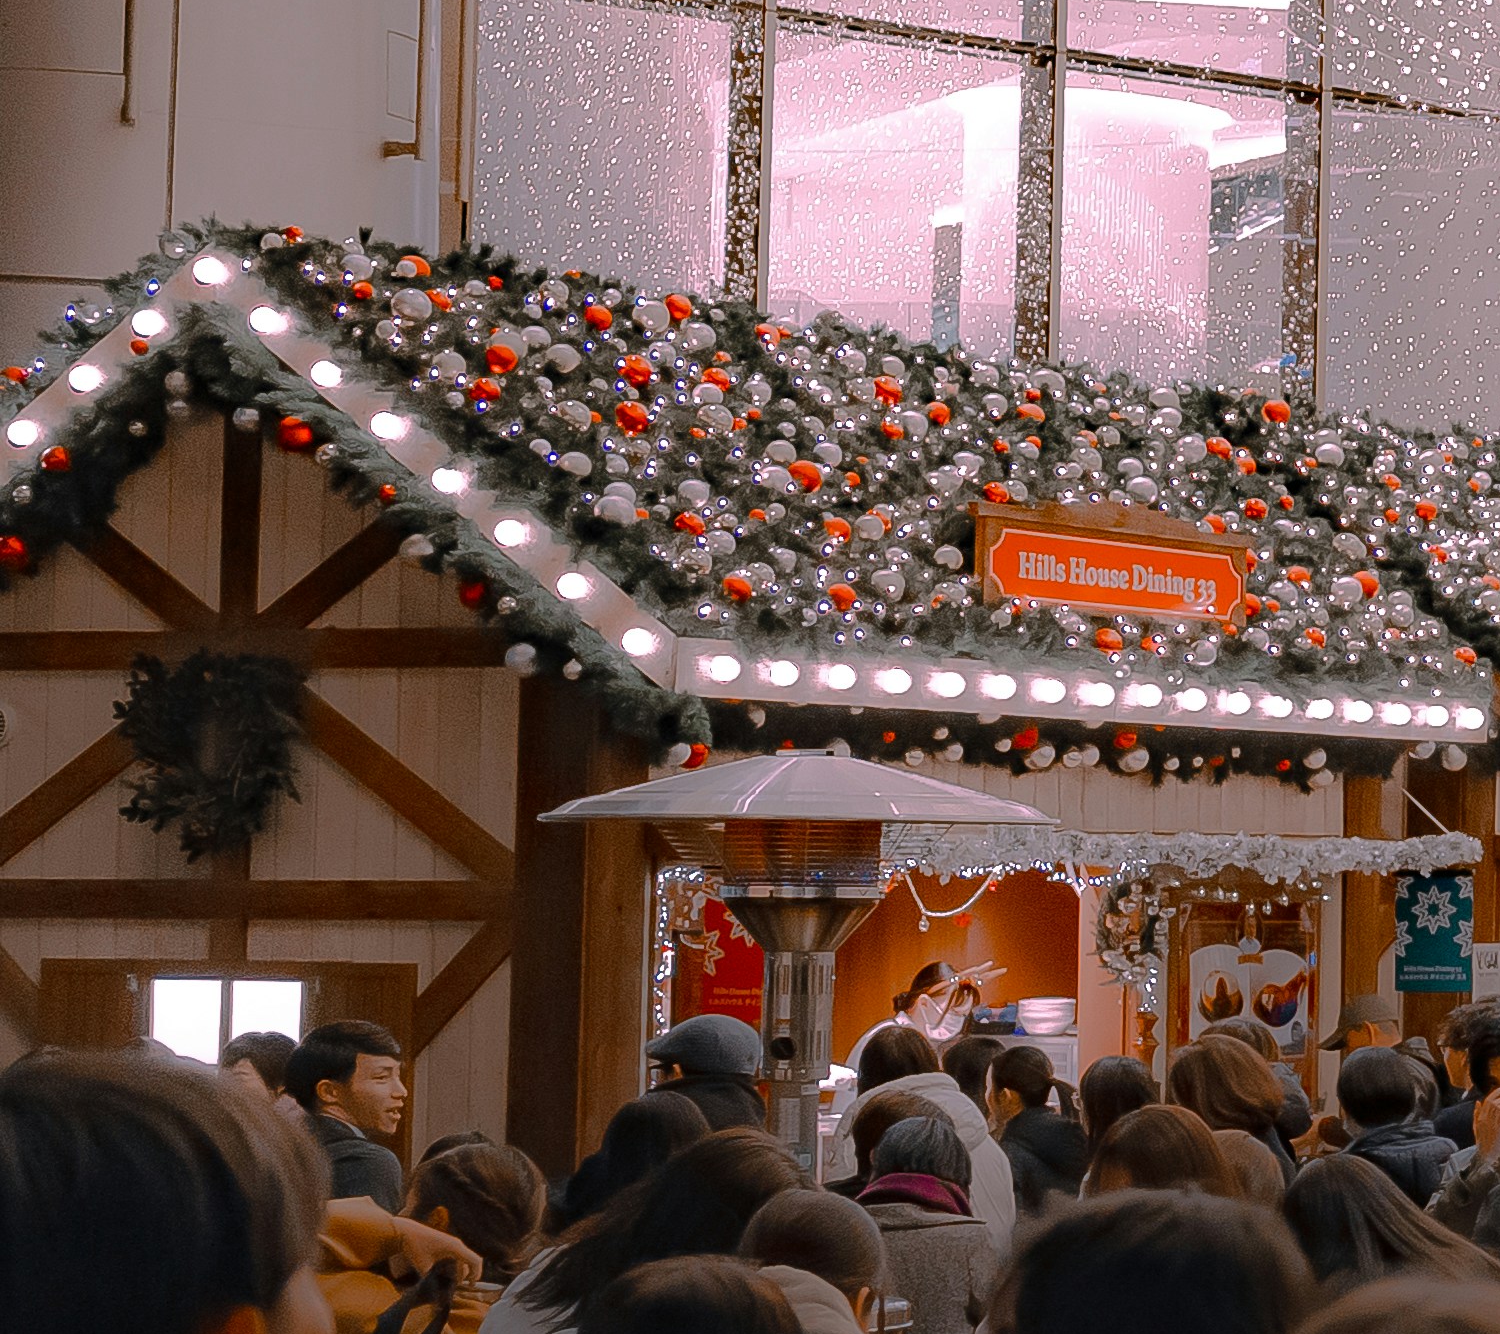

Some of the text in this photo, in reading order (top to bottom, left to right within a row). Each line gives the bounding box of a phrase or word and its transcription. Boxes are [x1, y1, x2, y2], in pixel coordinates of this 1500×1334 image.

[1018, 551, 1217, 603] Hills House Dining 33
